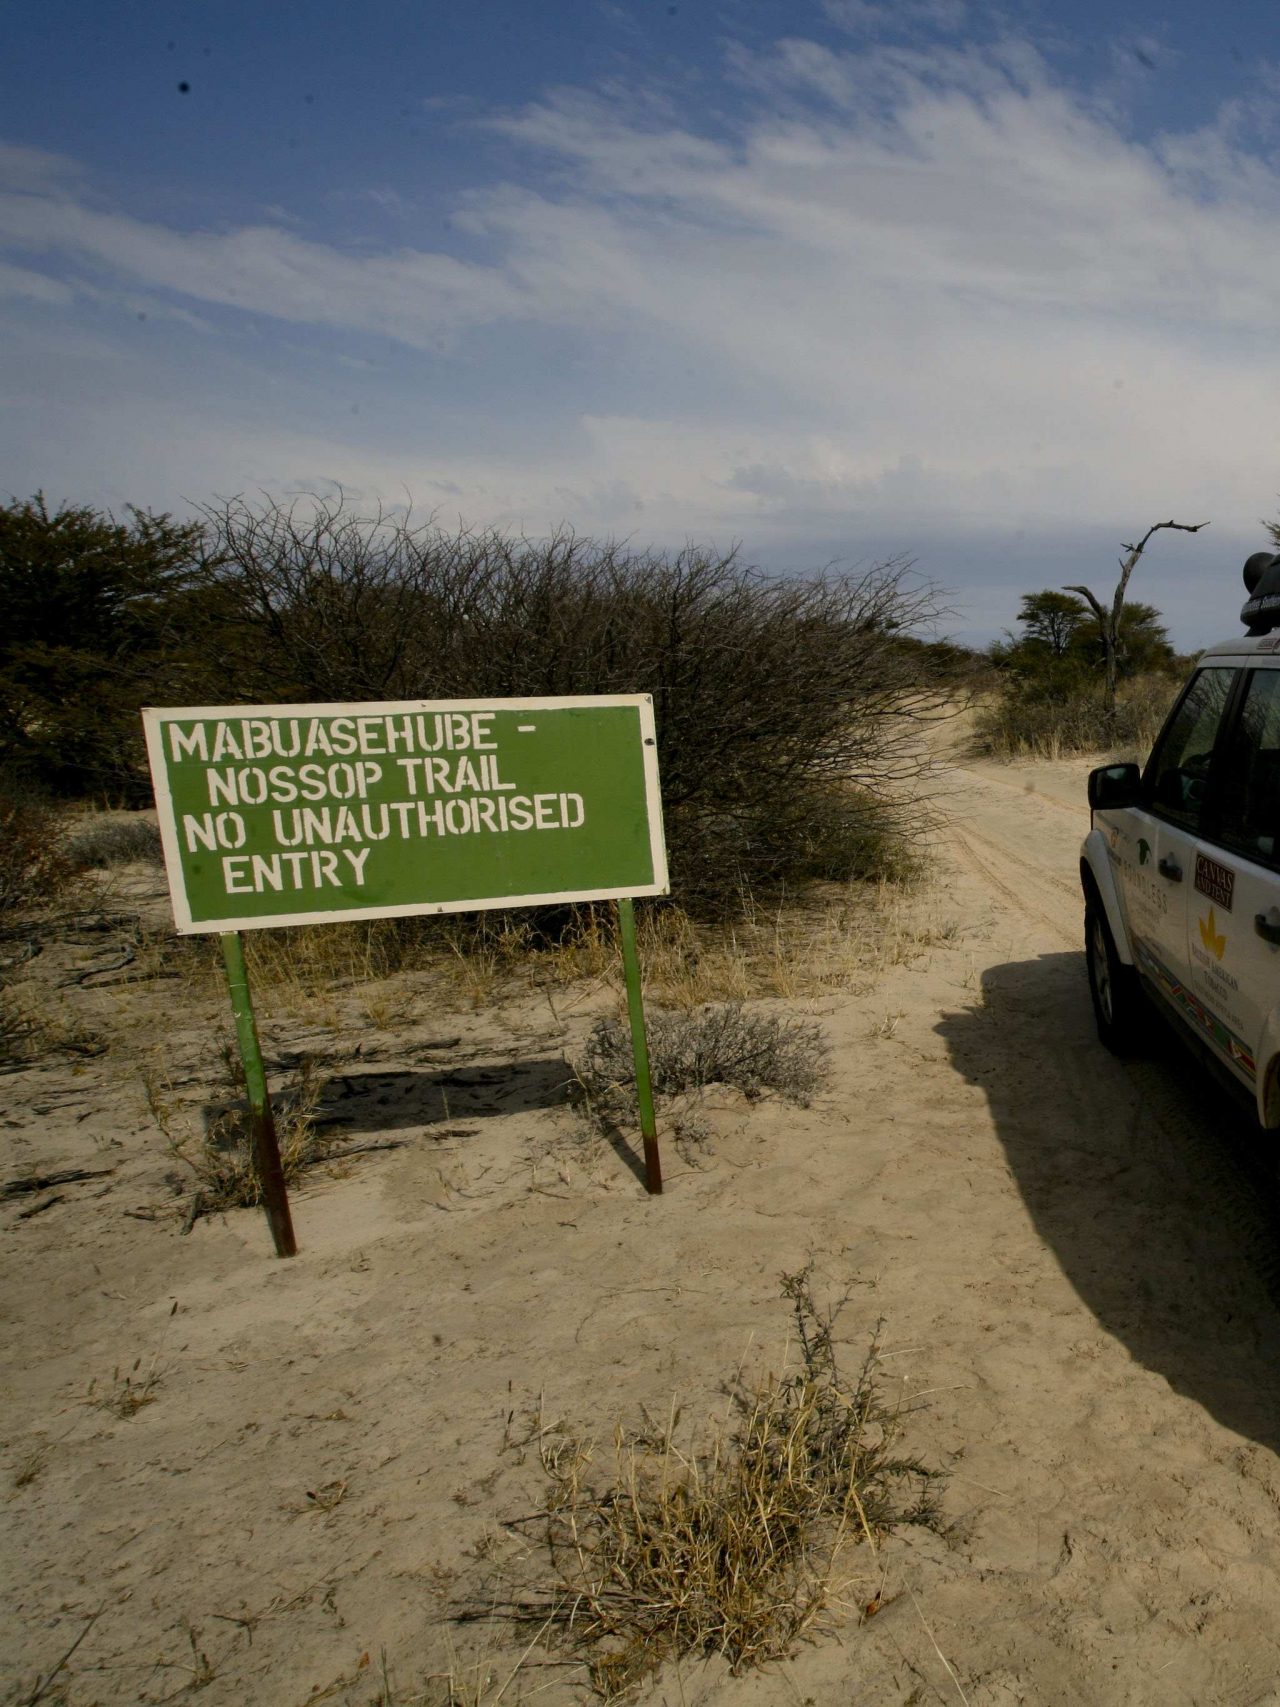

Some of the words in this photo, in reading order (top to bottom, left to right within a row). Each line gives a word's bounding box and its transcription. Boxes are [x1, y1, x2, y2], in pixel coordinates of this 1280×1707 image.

[168, 712, 498, 763] MABUASEHUBE
[207, 761, 383, 807] NOSSOP
[397, 755, 517, 796] TRAIL
[183, 811, 246, 853] NO
[272, 793, 586, 847] UNAUTHORISED
[222, 848, 371, 894] ENTRY
[1196, 857, 1234, 892] CANVAS
